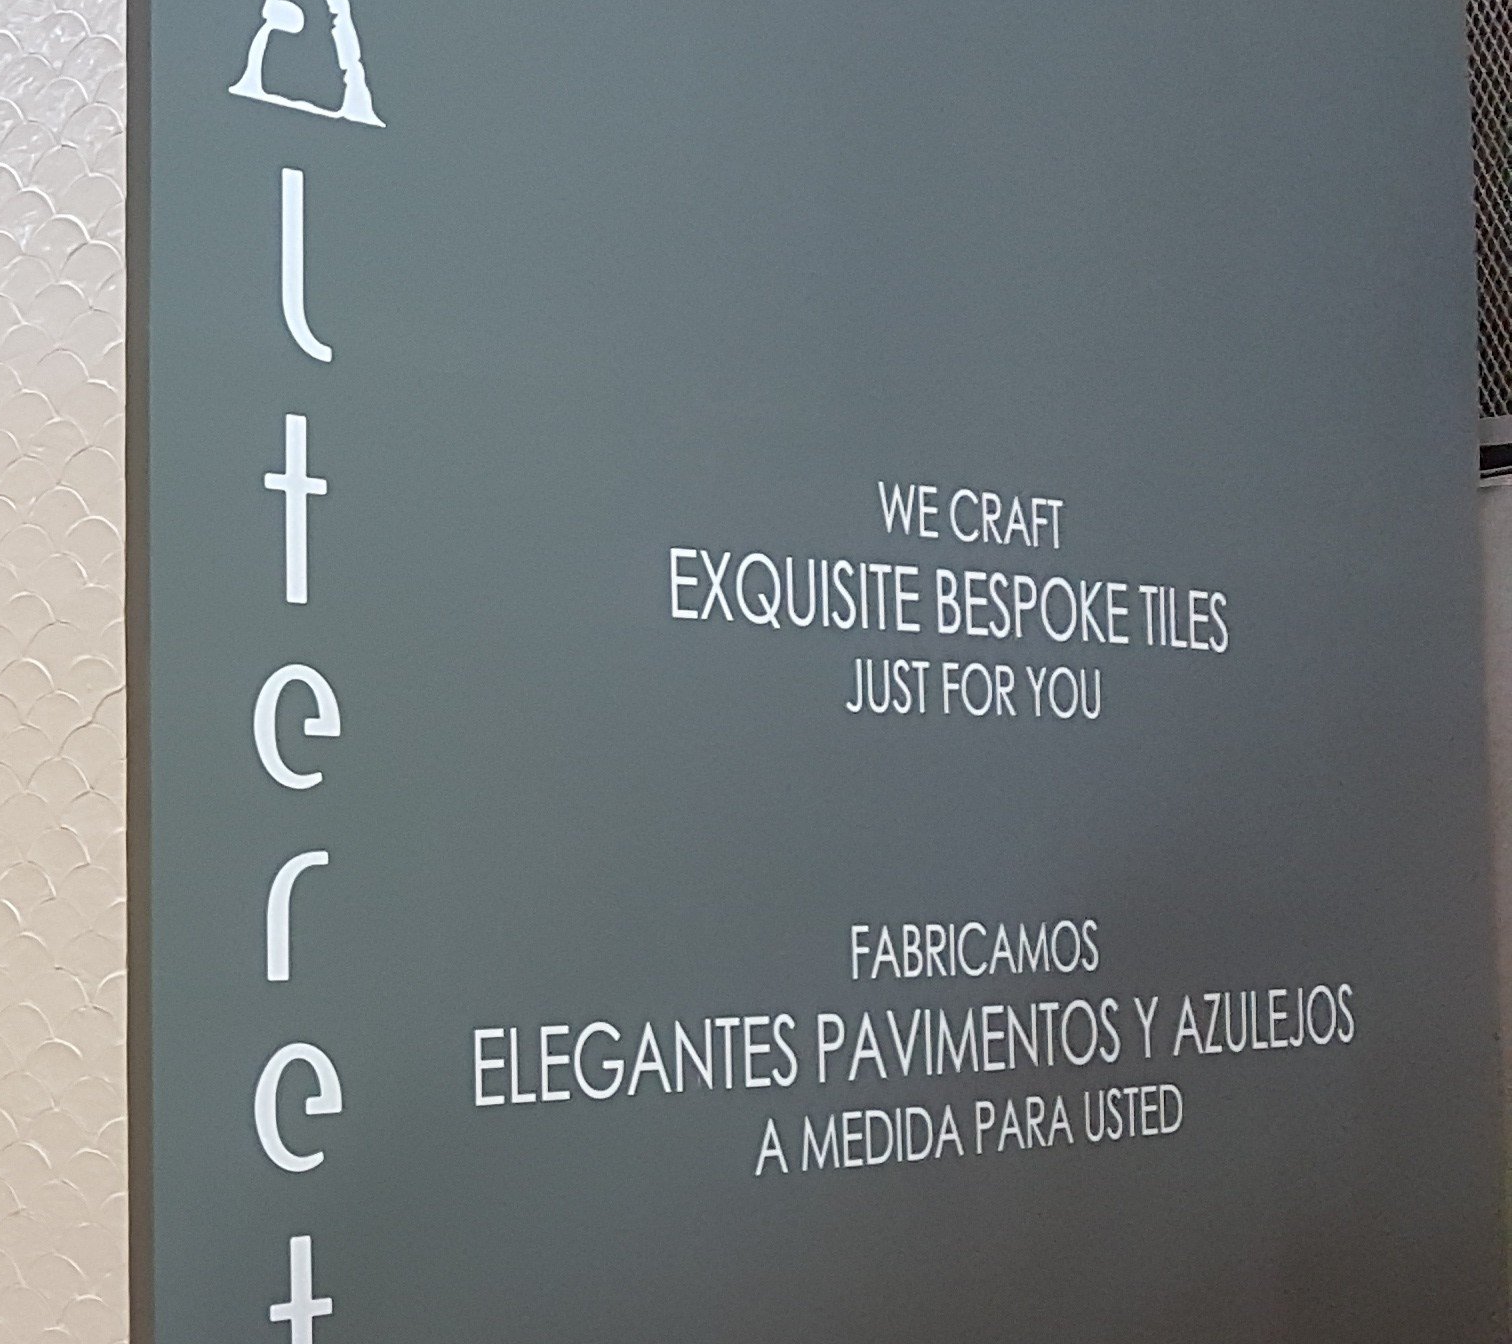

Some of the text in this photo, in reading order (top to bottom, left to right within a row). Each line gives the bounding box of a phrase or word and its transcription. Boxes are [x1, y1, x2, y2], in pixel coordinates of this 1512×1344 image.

[878, 481, 1064, 549] WE CRAFT
[670, 547, 1229, 653] EXQUISITE BESPOKE TILES
[846, 658, 1101, 720] JUST FOR YOU
[851, 919, 1099, 980] FABRICAMOS
[474, 983, 1355, 1107] ELEGANTES PAVIMENTOS Y AZULEJOS
[754, 1084, 1183, 1176] A MEDIDA PARA USTED
